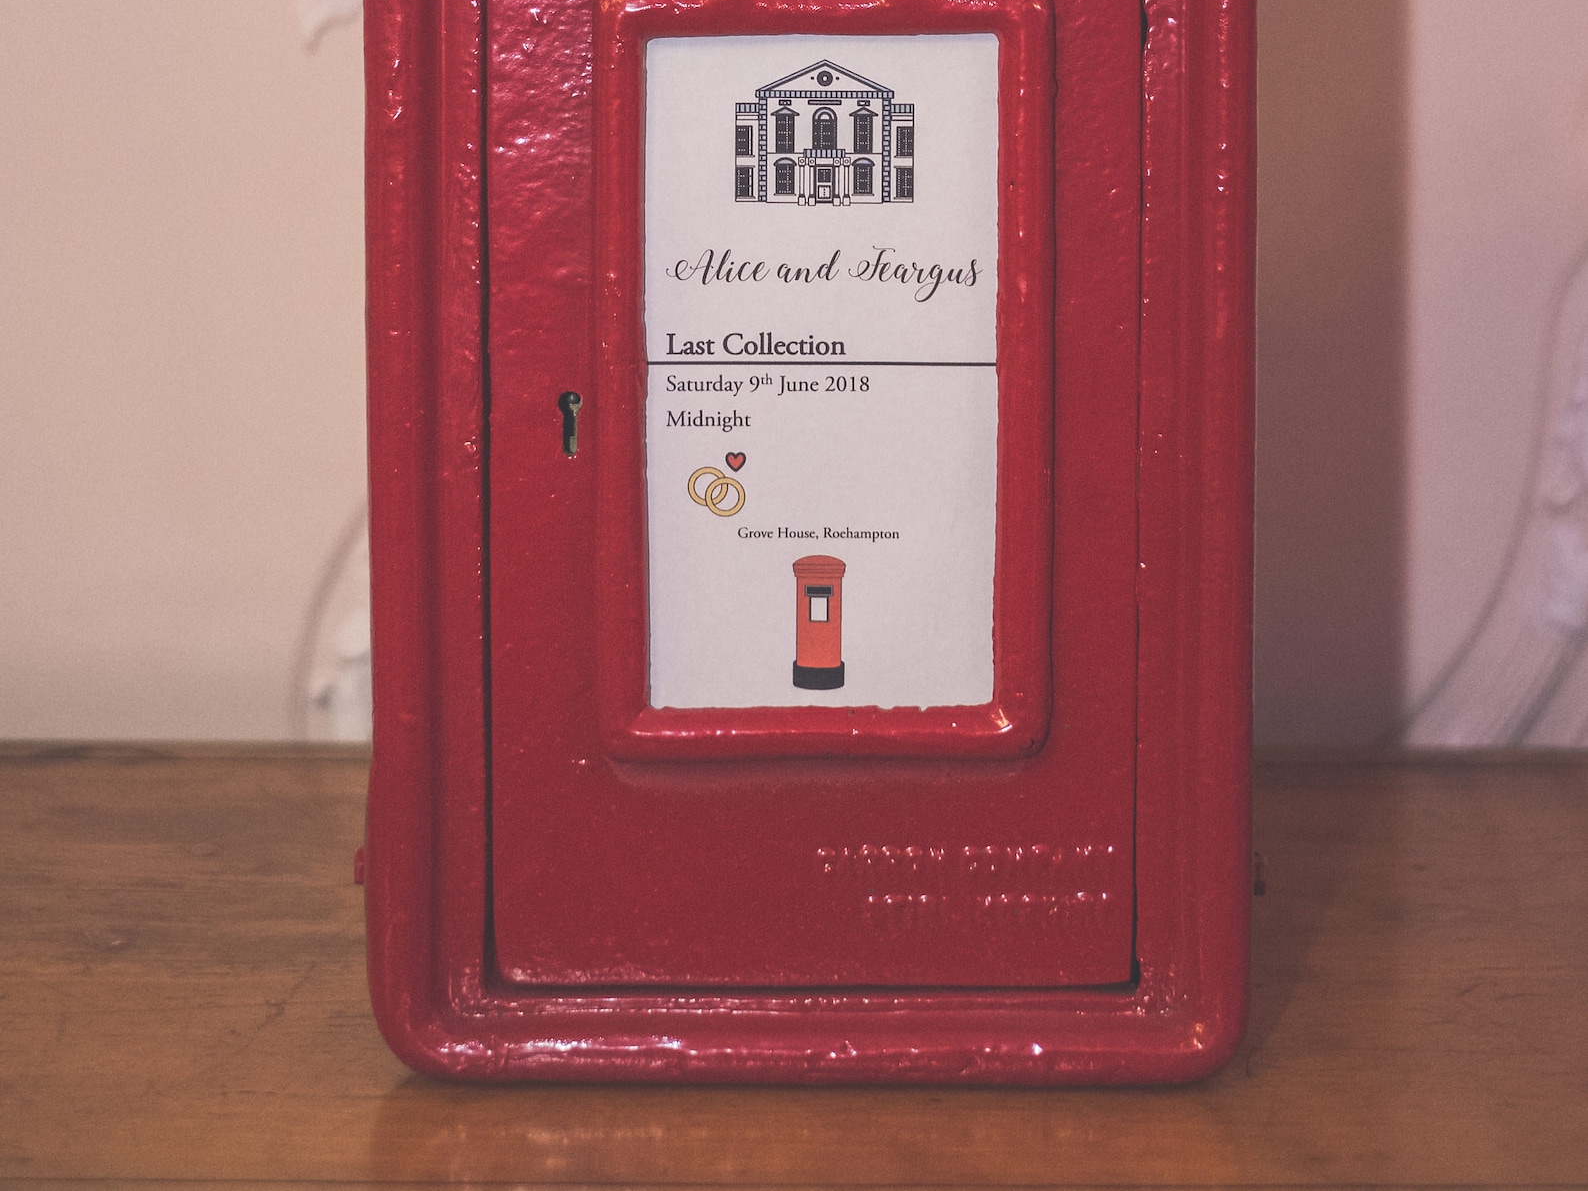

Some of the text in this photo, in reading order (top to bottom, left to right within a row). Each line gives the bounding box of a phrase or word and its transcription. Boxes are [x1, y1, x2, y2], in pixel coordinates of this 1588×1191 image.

[666, 246, 982, 302] Alice and Feargus
[666, 332, 846, 355] Last Collection
[667, 373, 869, 396] Saturday 9th June 2018
[667, 410, 751, 432] Midnight
[738, 527, 899, 542] Grove House, Roehampton
